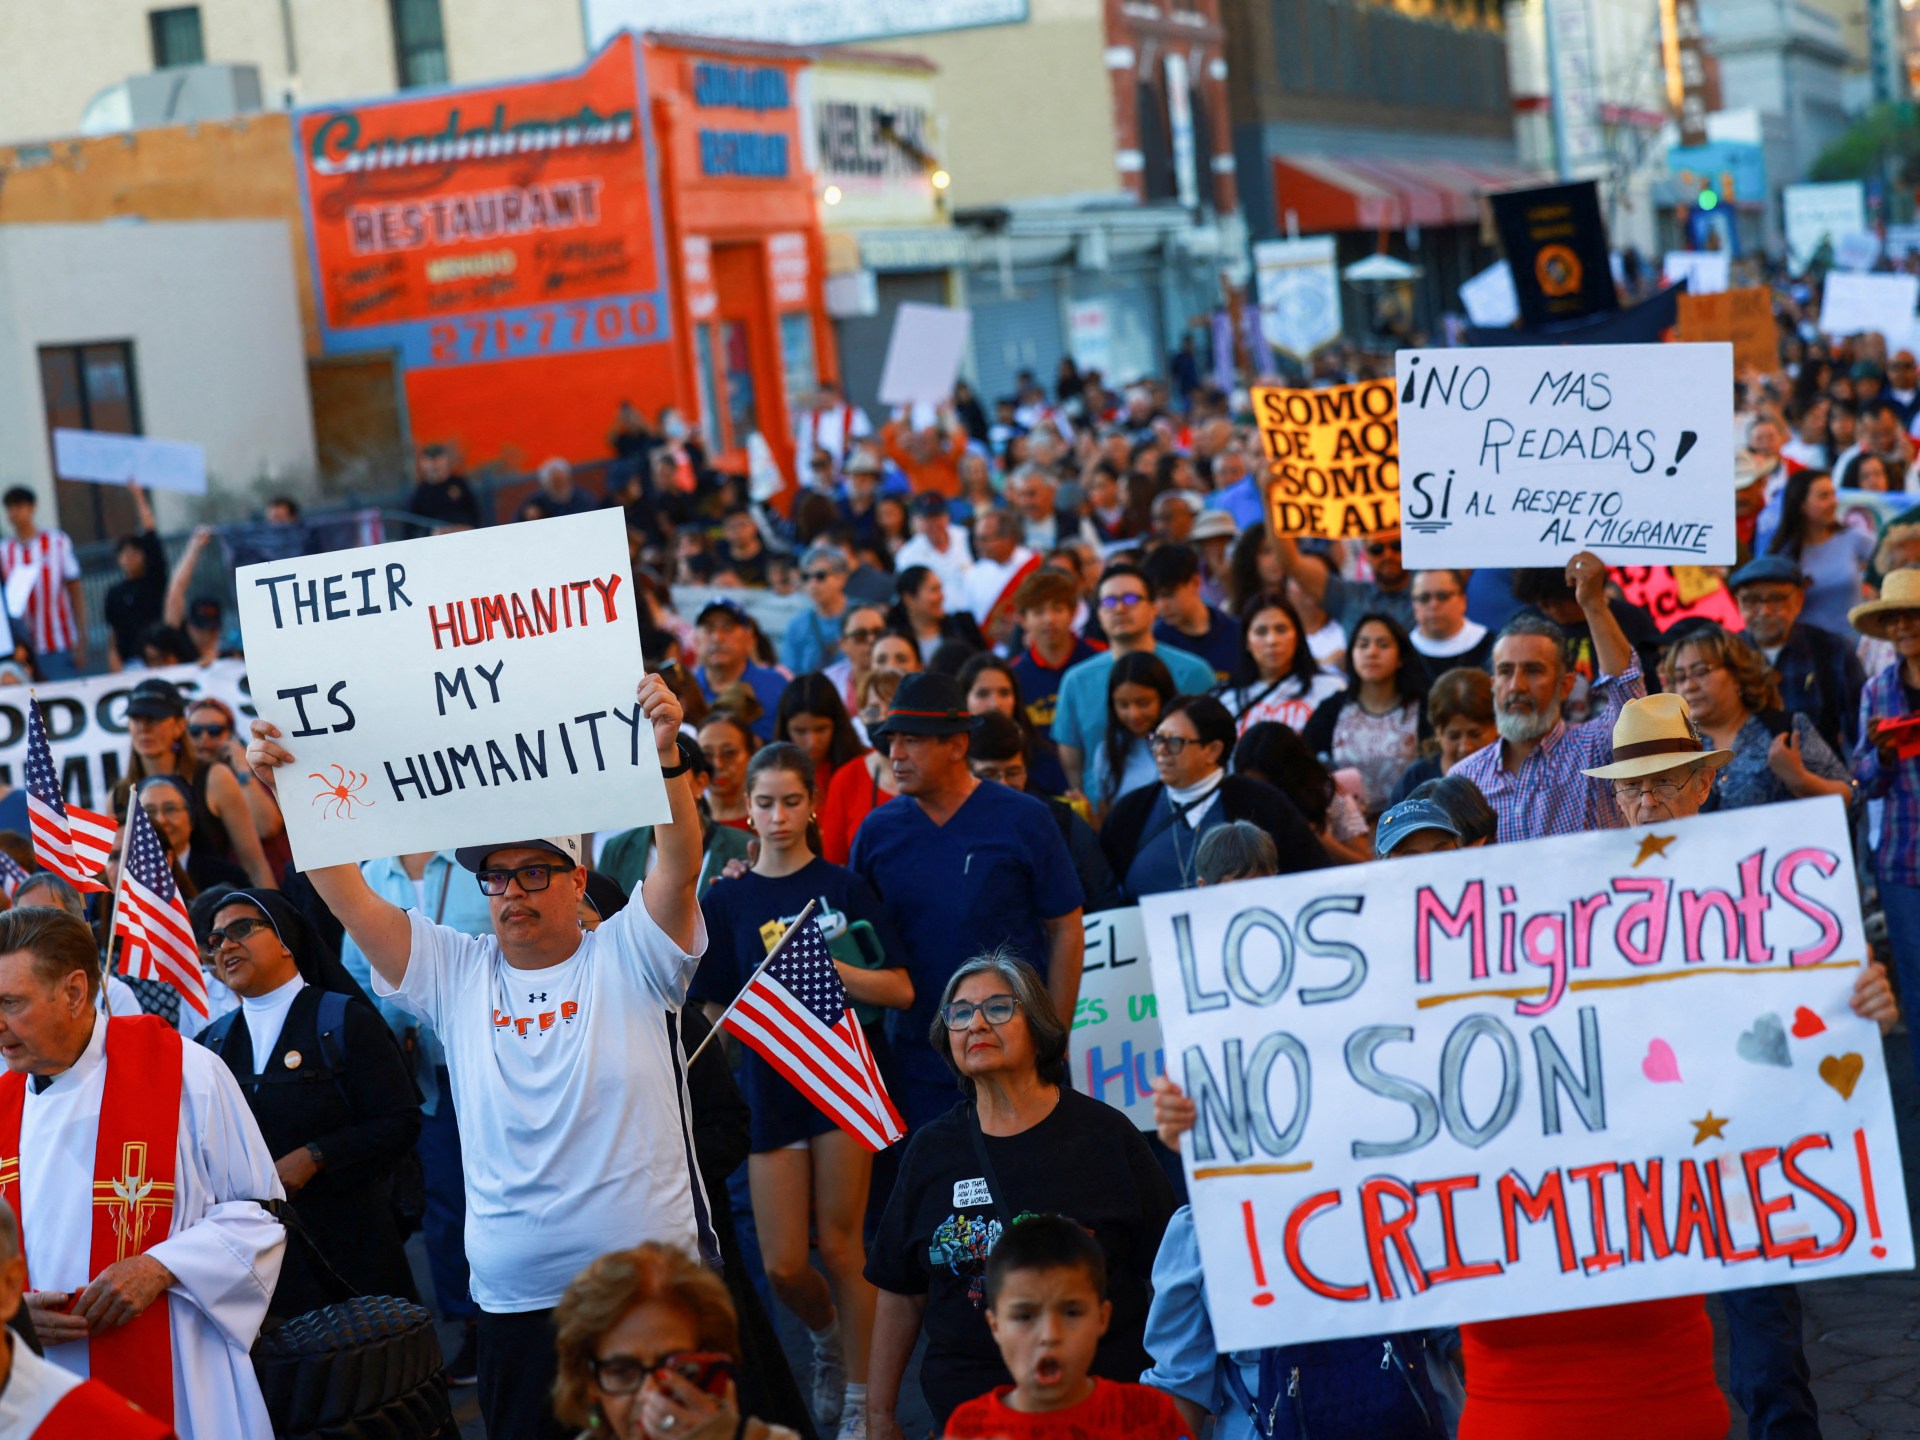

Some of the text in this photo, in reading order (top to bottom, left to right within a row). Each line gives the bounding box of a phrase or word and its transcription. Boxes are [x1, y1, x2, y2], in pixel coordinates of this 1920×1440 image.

[345, 178, 604, 256] RESTAURANT
[1529, 370, 1612, 411] MAS
[1266, 420, 1398, 461] DE AQ
[1279, 503, 1329, 533] DE
[1465, 490, 1496, 517] AL
[1511, 487, 1623, 517] RESPETO
[1540, 517, 1714, 550] AL MIGRANTE
[255, 562, 623, 650] THEIR HUMANITY
[276, 680, 356, 738] IS
[434, 659, 504, 716] MY
[383, 702, 641, 802] HUMANITY
[1171, 895, 1369, 1015] LOS
[1182, 1006, 1608, 1164] NO SON
[970, 1197, 989, 1205] WORLD
[974, 1188, 990, 1196] SAVE
